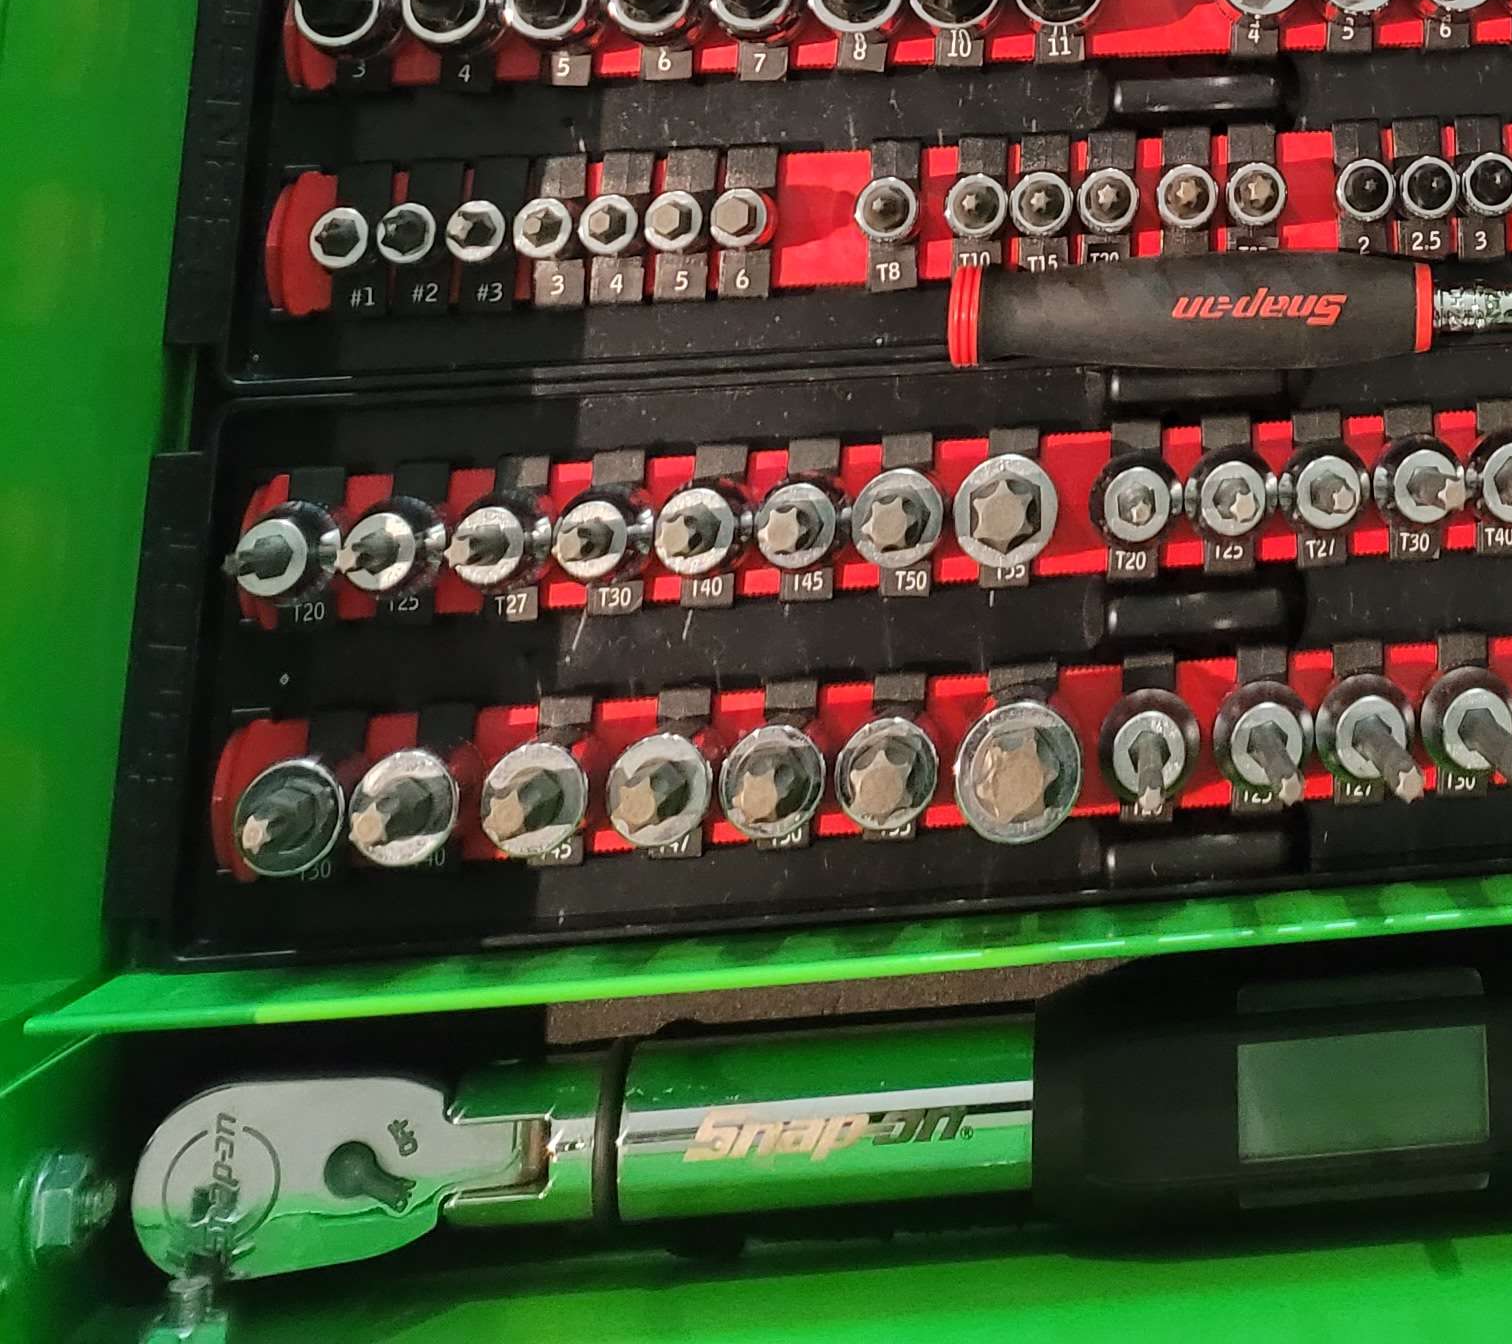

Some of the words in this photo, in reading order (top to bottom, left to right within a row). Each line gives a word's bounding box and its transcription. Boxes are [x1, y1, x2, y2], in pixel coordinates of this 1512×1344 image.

[1247, 23, 1262, 43] 4
[1342, 21, 1354, 41] 5
[1439, 19, 1452, 39] 6
[853, 40, 867, 61] 8
[947, 38, 972, 58] 10
[1048, 37, 1072, 57] 11
[353, 60, 366, 79] 3
[557, 56, 570, 76] 5
[658, 52, 671, 72] 6
[753, 52, 766, 73] 7
[457, 64, 470, 84] 4
[1358, 236, 1370, 255] 2
[1411, 232, 1442, 252] 2.5
[1474, 232, 1488, 252] 3
[675, 271, 688, 291] 5
[736, 269, 750, 290] 6
[876, 262, 901, 282] T8
[411, 283, 439, 303] #2
[476, 282, 504, 302] #3
[551, 274, 564, 294] 3
[610, 273, 623, 294] 4
[350, 287, 376, 307] #1
[1173, 285, 1348, 328] Snap-on
[1400, 532, 1430, 553] T30
[1116, 550, 1147, 571] T20
[895, 570, 928, 592] T50
[495, 594, 527, 614] T27
[600, 587, 632, 609] T30
[294, 602, 325, 622] T20
